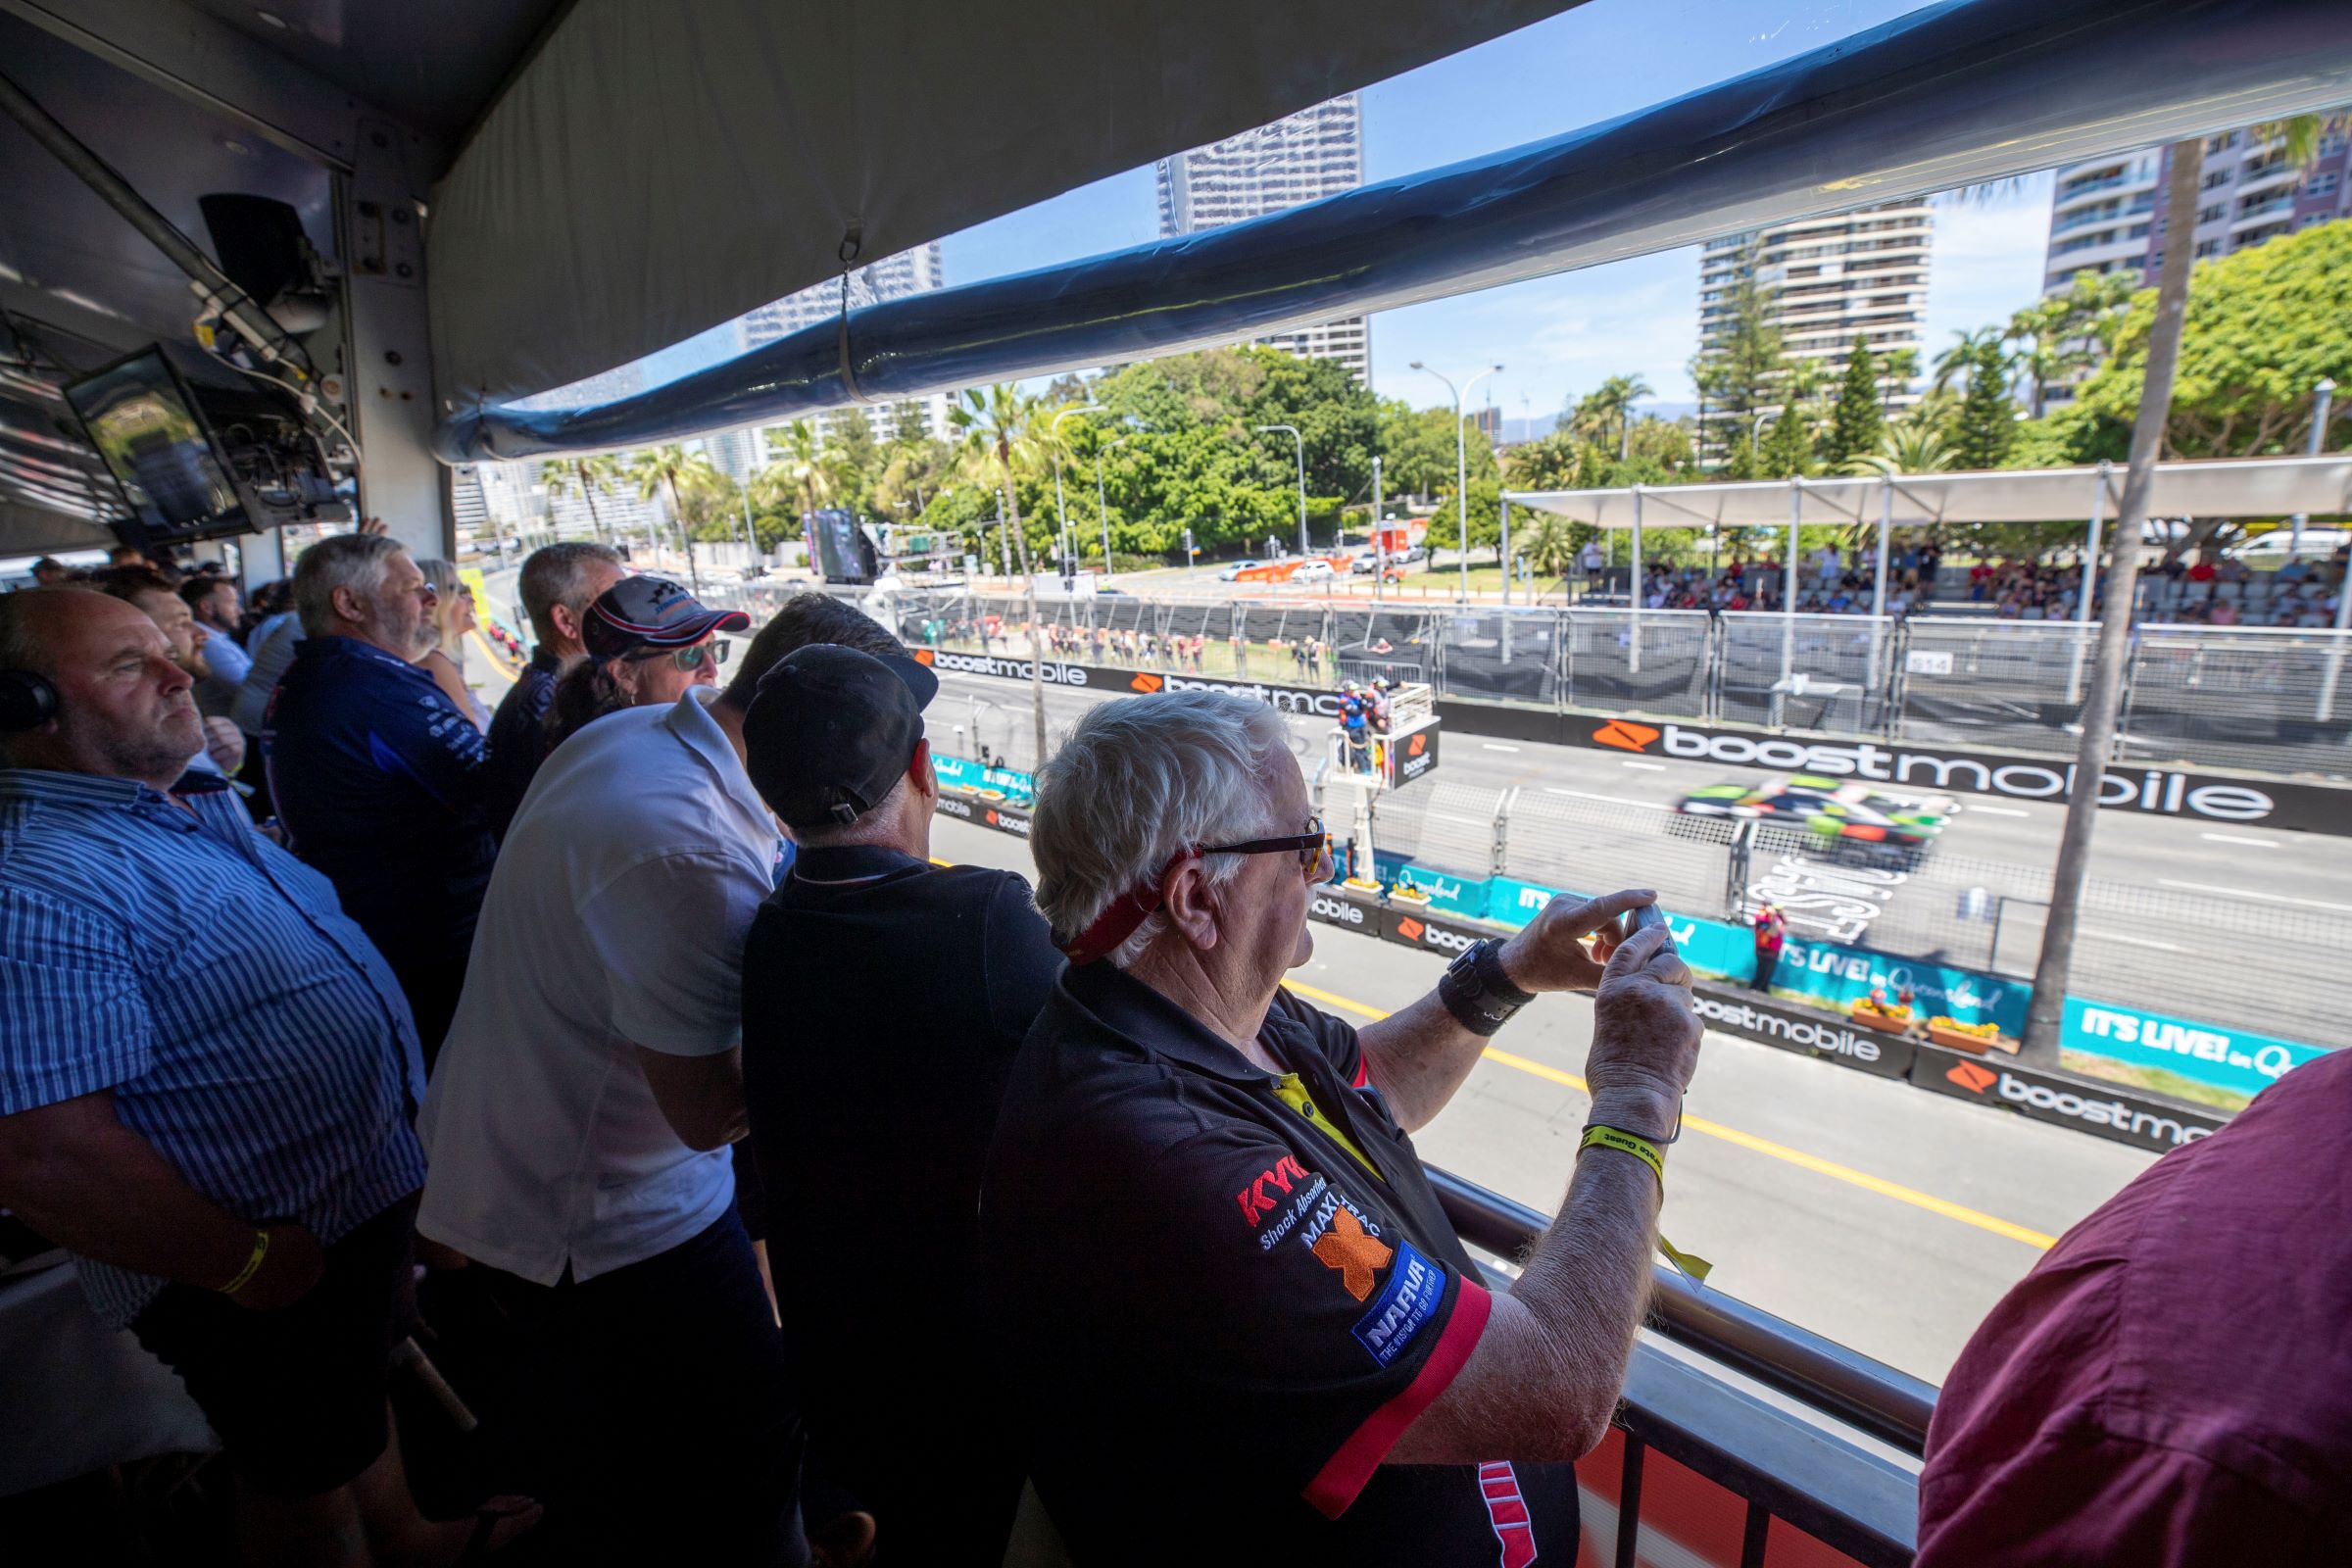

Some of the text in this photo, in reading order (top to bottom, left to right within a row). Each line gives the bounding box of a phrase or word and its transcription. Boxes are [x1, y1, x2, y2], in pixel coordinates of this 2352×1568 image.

[934, 650, 1088, 686] boostmobile
[1663, 724, 2275, 820] boostmobile
[1808, 949, 1871, 982] LIVE!
[1693, 996, 1882, 1062] oostmobile
[2140, 1020, 2230, 1063] LIVE!
[1603, 1133, 1637, 1151] Guest
[1259, 1208, 1298, 1250] Shock
[1367, 1258, 1426, 1348] NARVA
[1379, 1268, 1437, 1362] THE VISION TO GO FURTHER
